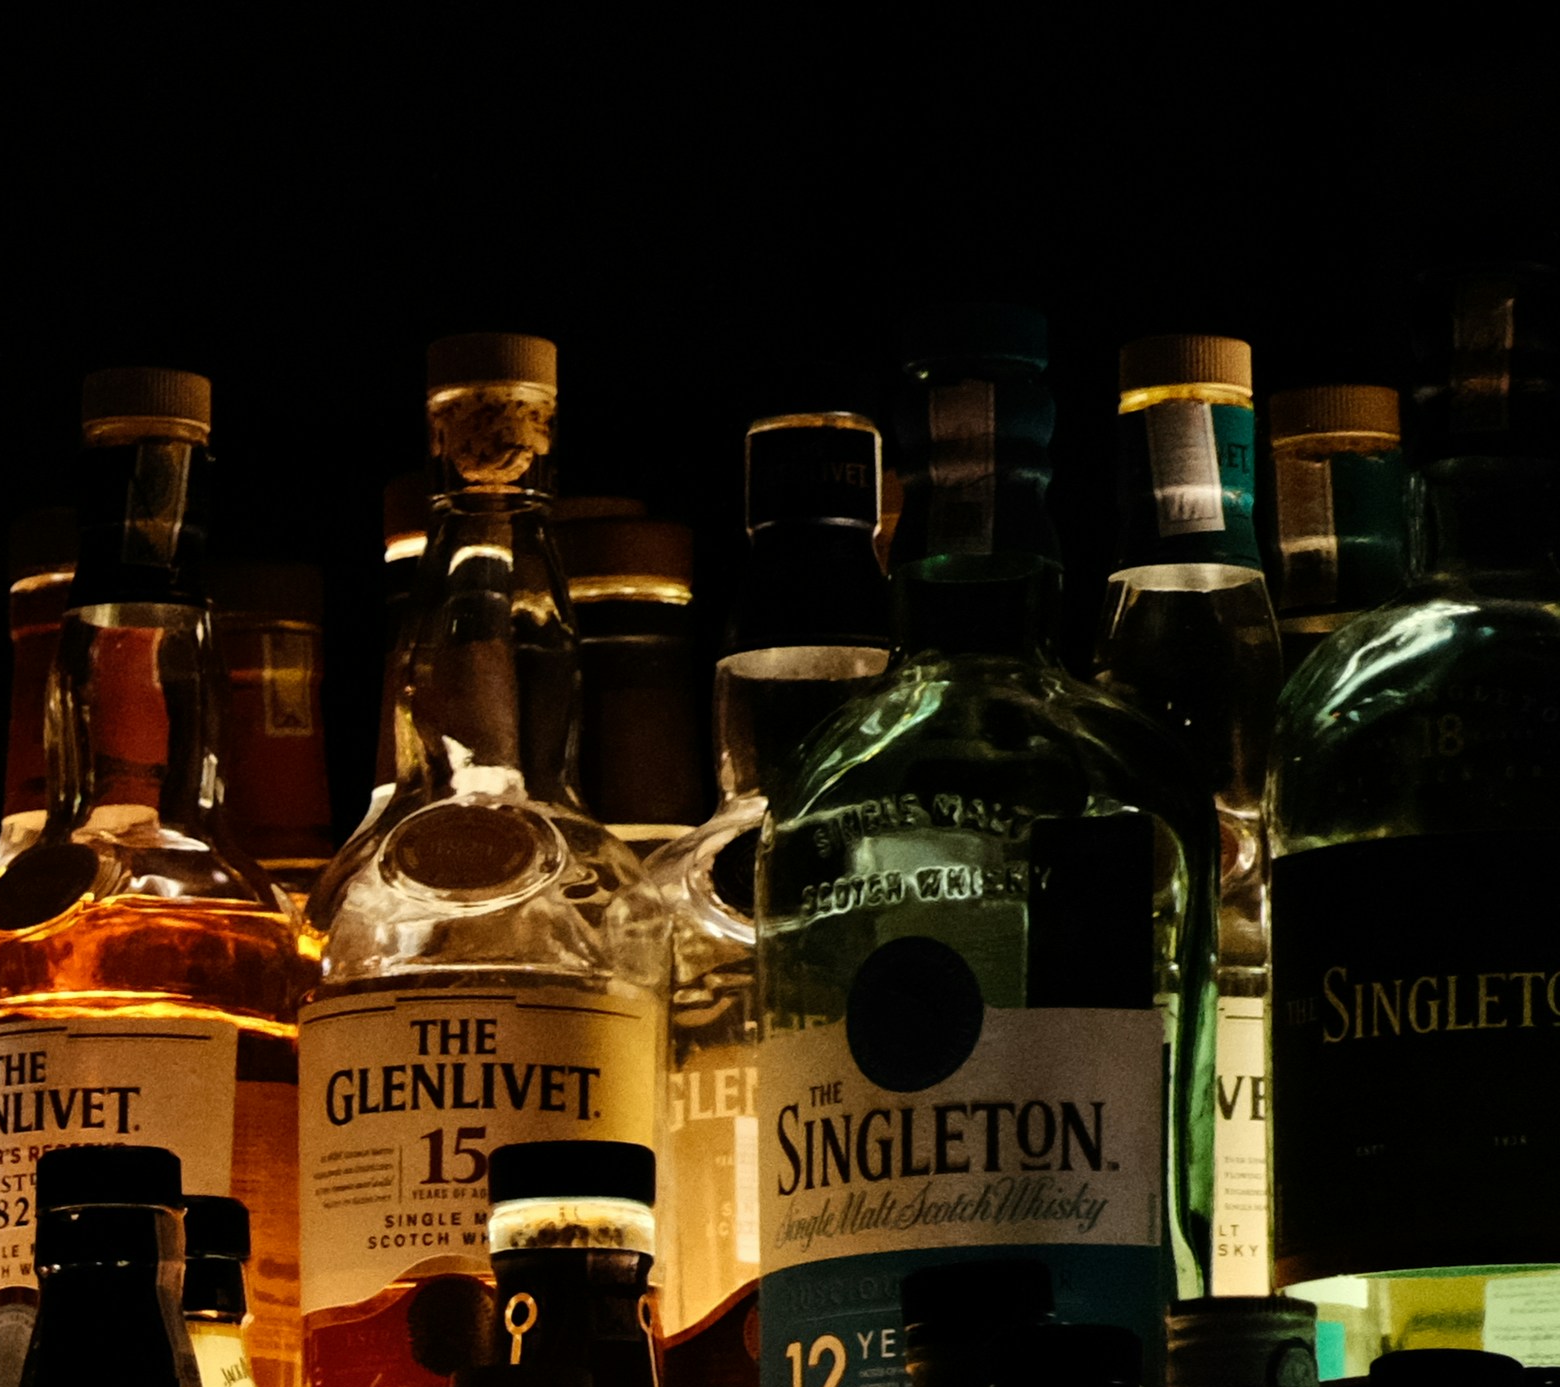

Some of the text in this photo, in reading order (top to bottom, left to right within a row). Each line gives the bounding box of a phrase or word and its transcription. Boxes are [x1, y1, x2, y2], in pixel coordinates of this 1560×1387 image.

[411, 1019, 496, 1055] THE
[809, 1082, 842, 1106] THE
[420, 1127, 487, 1184] 15
[777, 1100, 1104, 1195] SINGLETON
[385, 1213, 460, 1228] SINGLE
[776, 1176, 1107, 1250] Single Malt Scotch Whisky
[367, 1232, 449, 1249] SCOTCH
[1218, 1244, 1260, 1258] SKY
[857, 1328, 904, 1359] YE
